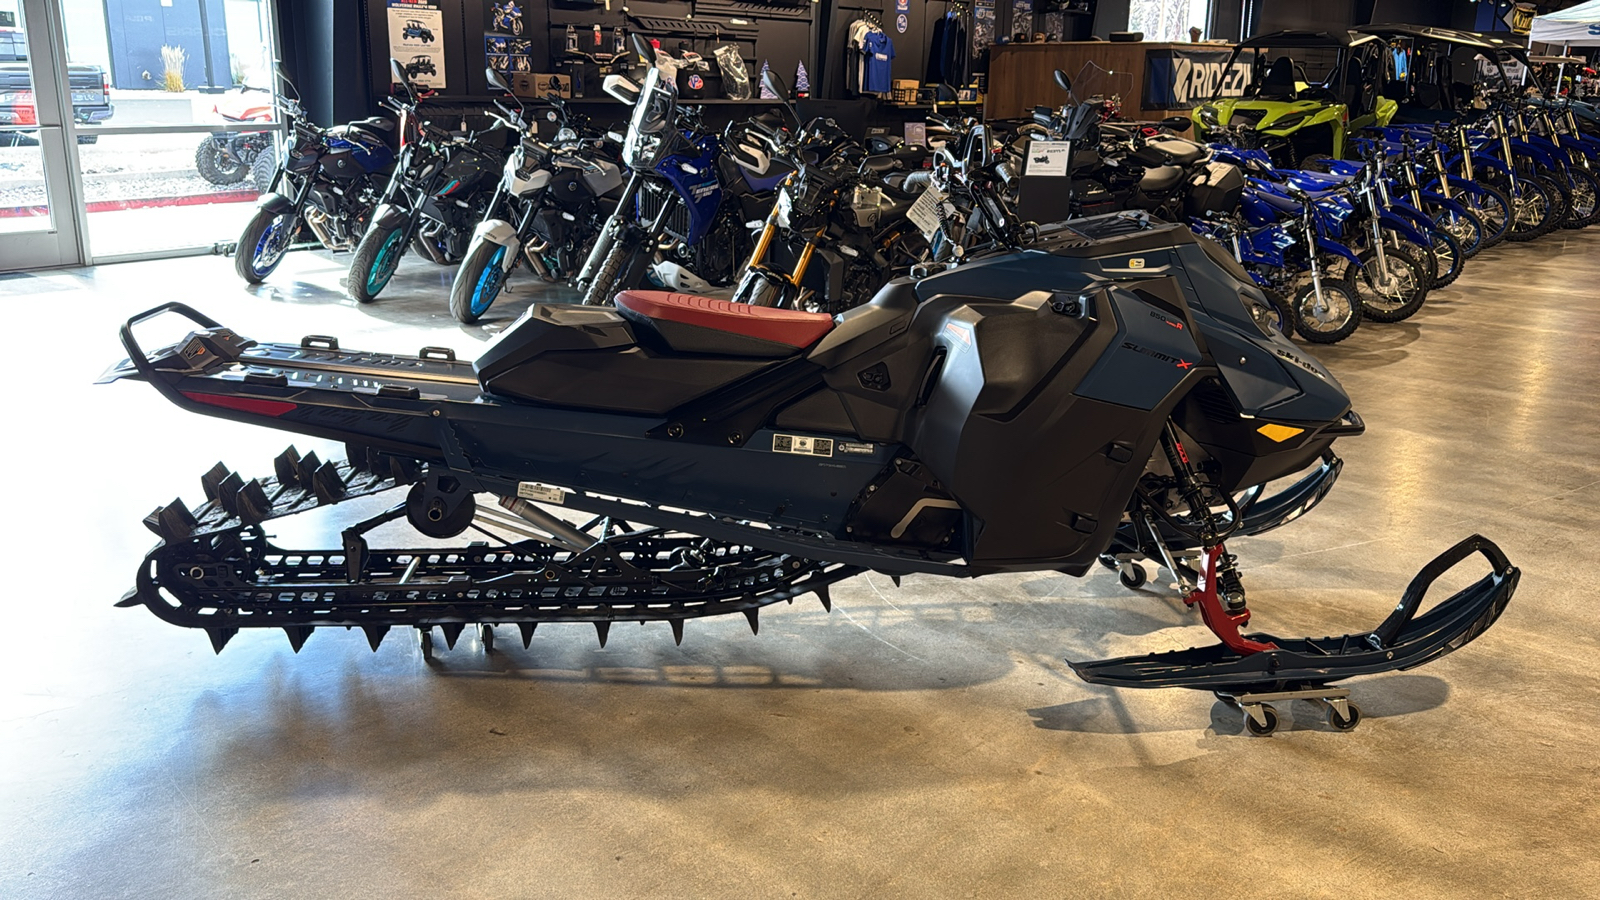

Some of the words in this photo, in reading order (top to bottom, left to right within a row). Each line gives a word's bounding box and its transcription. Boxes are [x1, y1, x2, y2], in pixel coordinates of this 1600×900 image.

[1149, 311, 1166, 322] 850
[1121, 342, 1180, 363] SUMMIT
[1176, 358, 1193, 370] X
